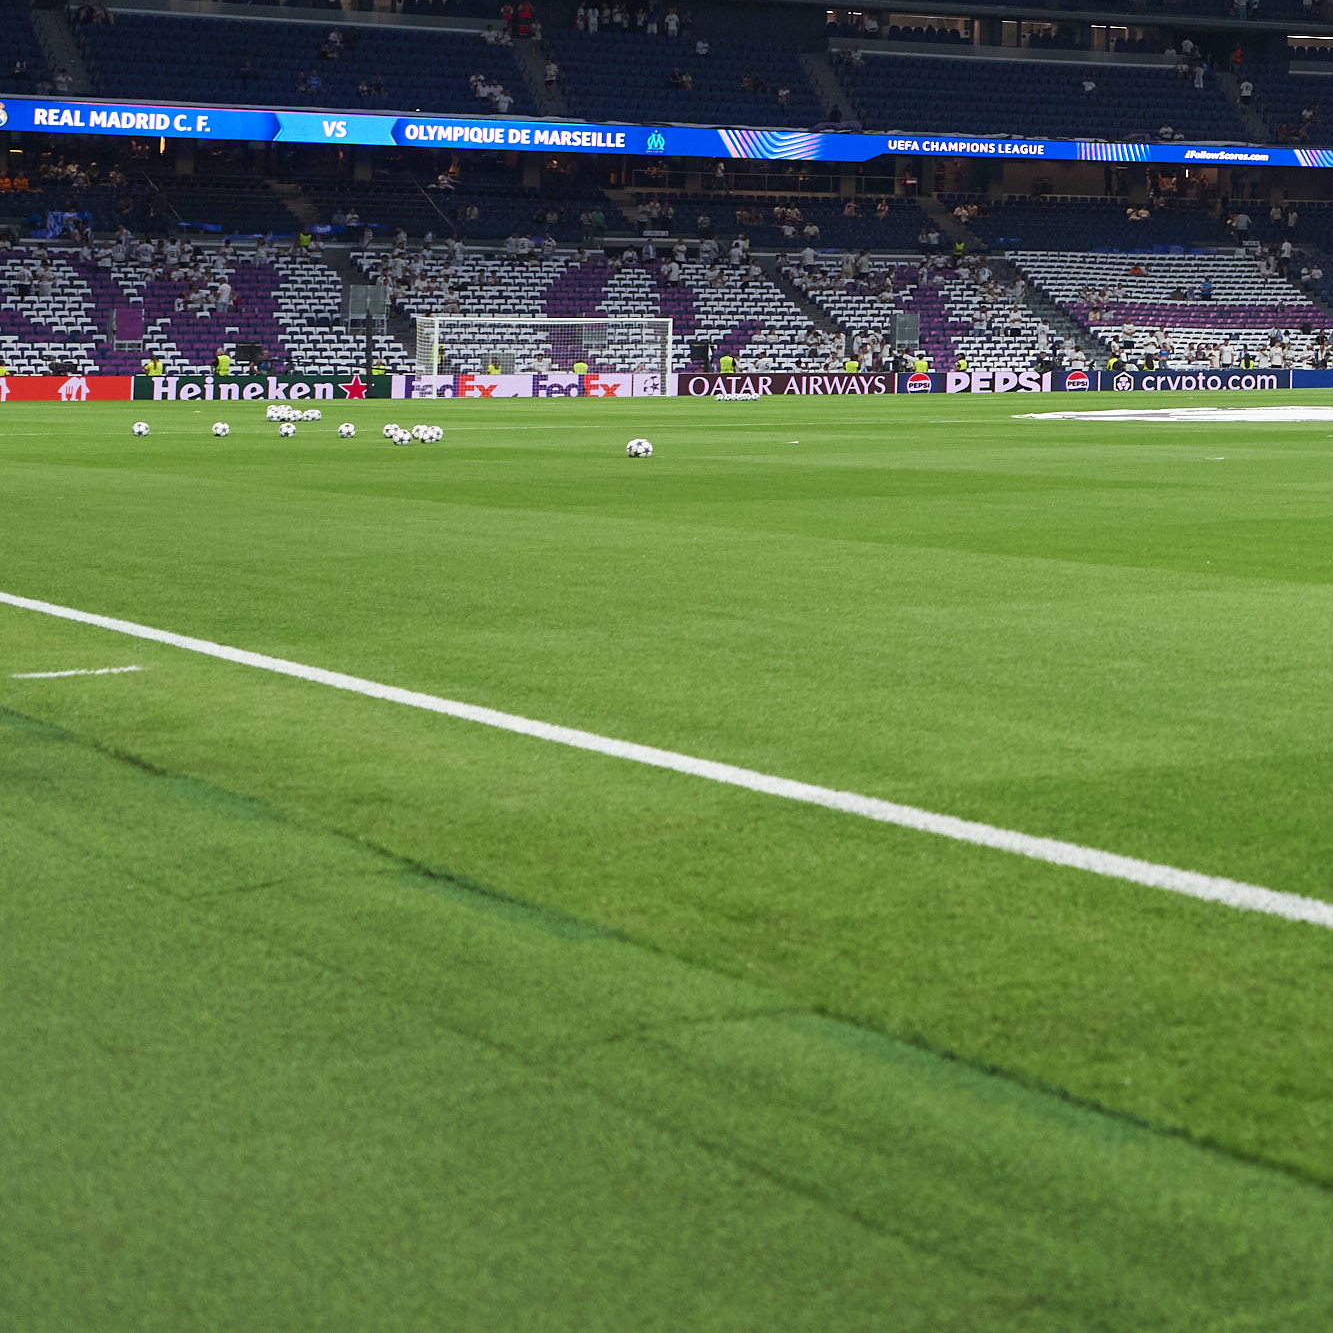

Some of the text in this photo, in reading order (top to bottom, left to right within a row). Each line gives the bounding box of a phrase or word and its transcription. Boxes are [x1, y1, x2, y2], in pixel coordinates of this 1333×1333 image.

[34, 108, 211, 133] REAL MADRID C. F.
[323, 120, 347, 138] VS
[405, 124, 625, 148] OLYMPIQUE DE MARSEILLE
[888, 139, 1044, 155] UEFA CHAMPIONS LEAGUE
[151, 376, 343, 400] Heineken
[533, 374, 621, 397] FedEx
[688, 374, 886, 396] QATAR AIRWAYS
[907, 380, 931, 389] PEPSI
[947, 372, 1051, 392] PEPSI
[1067, 380, 1090, 389] PEPSI
[1142, 373, 1277, 391] crypto.com
